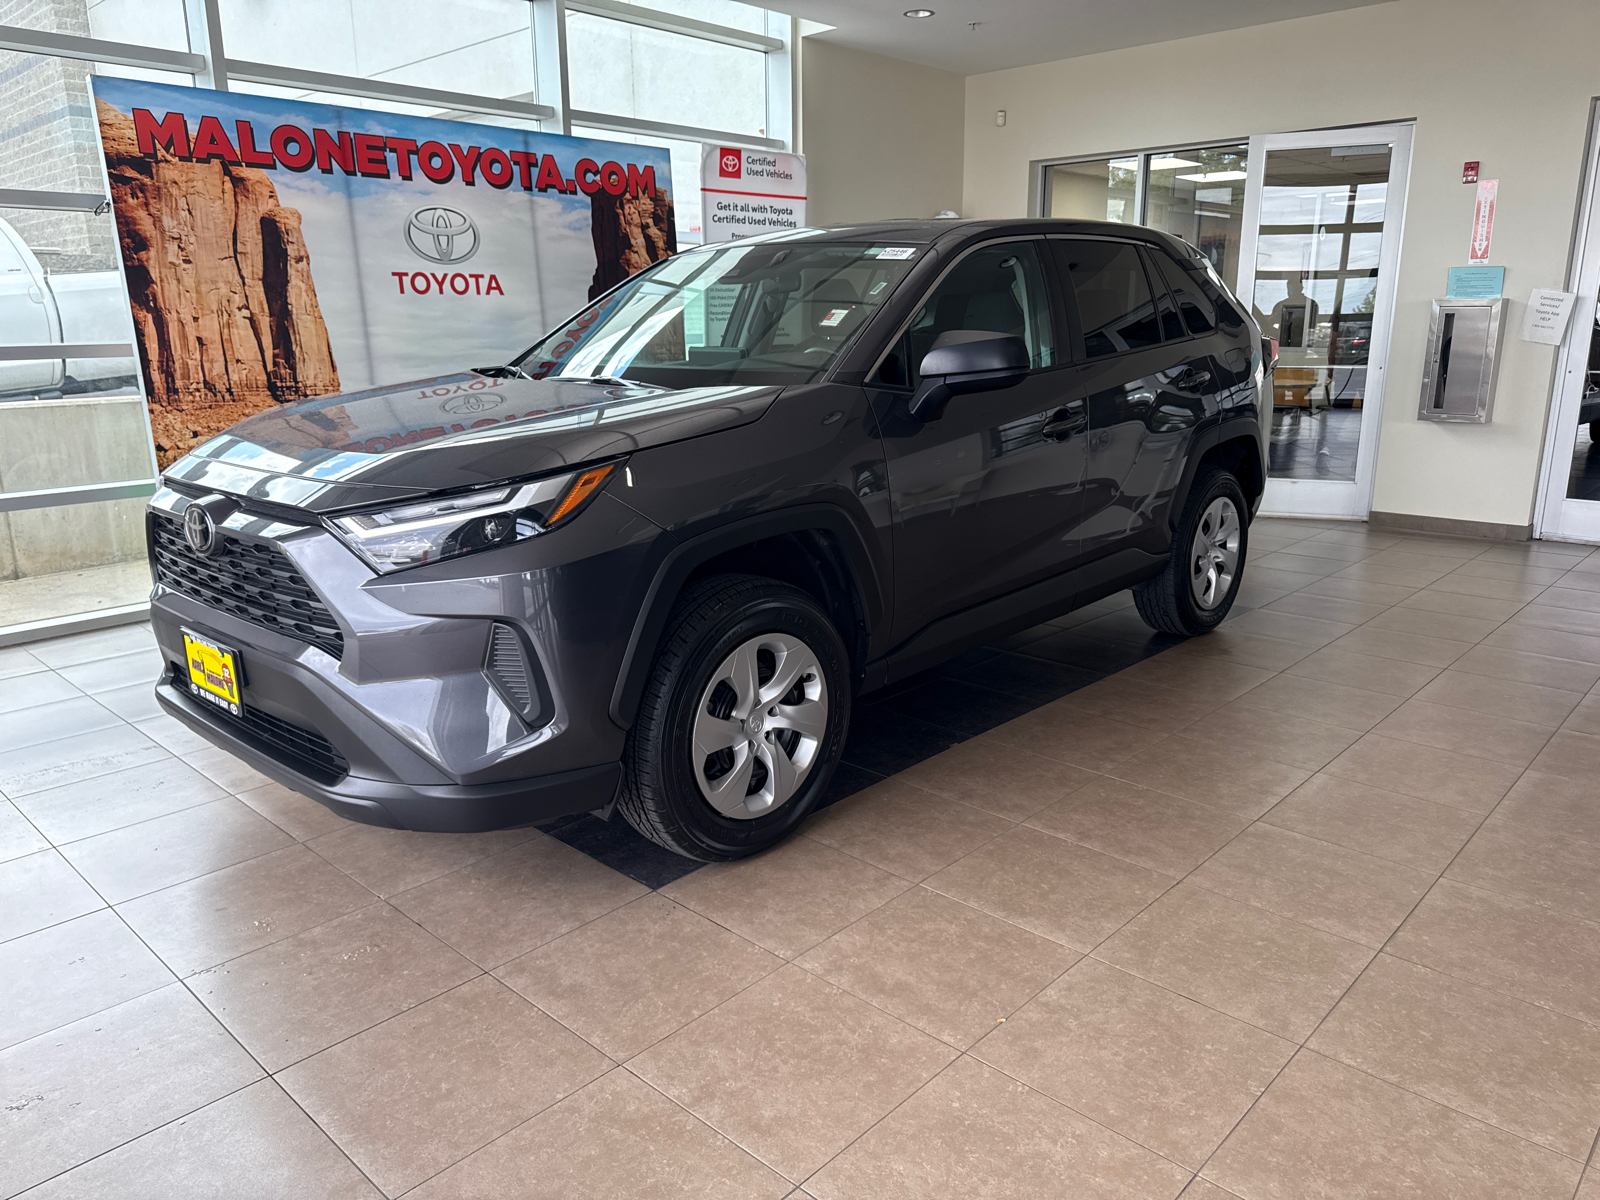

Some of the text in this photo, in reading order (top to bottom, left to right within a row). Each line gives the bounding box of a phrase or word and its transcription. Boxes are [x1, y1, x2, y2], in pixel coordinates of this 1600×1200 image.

[132, 108, 656, 198] MALONETOYOTA.COM
[746, 156, 776, 167] Certified
[746, 167, 793, 180] Used Vehicles
[716, 202, 793, 216] Get it all with Toyota
[712, 214, 797, 228] Certified Used Vehicles
[391, 271, 505, 296] TOYOTA
[1540, 295, 1564, 303] Connected
